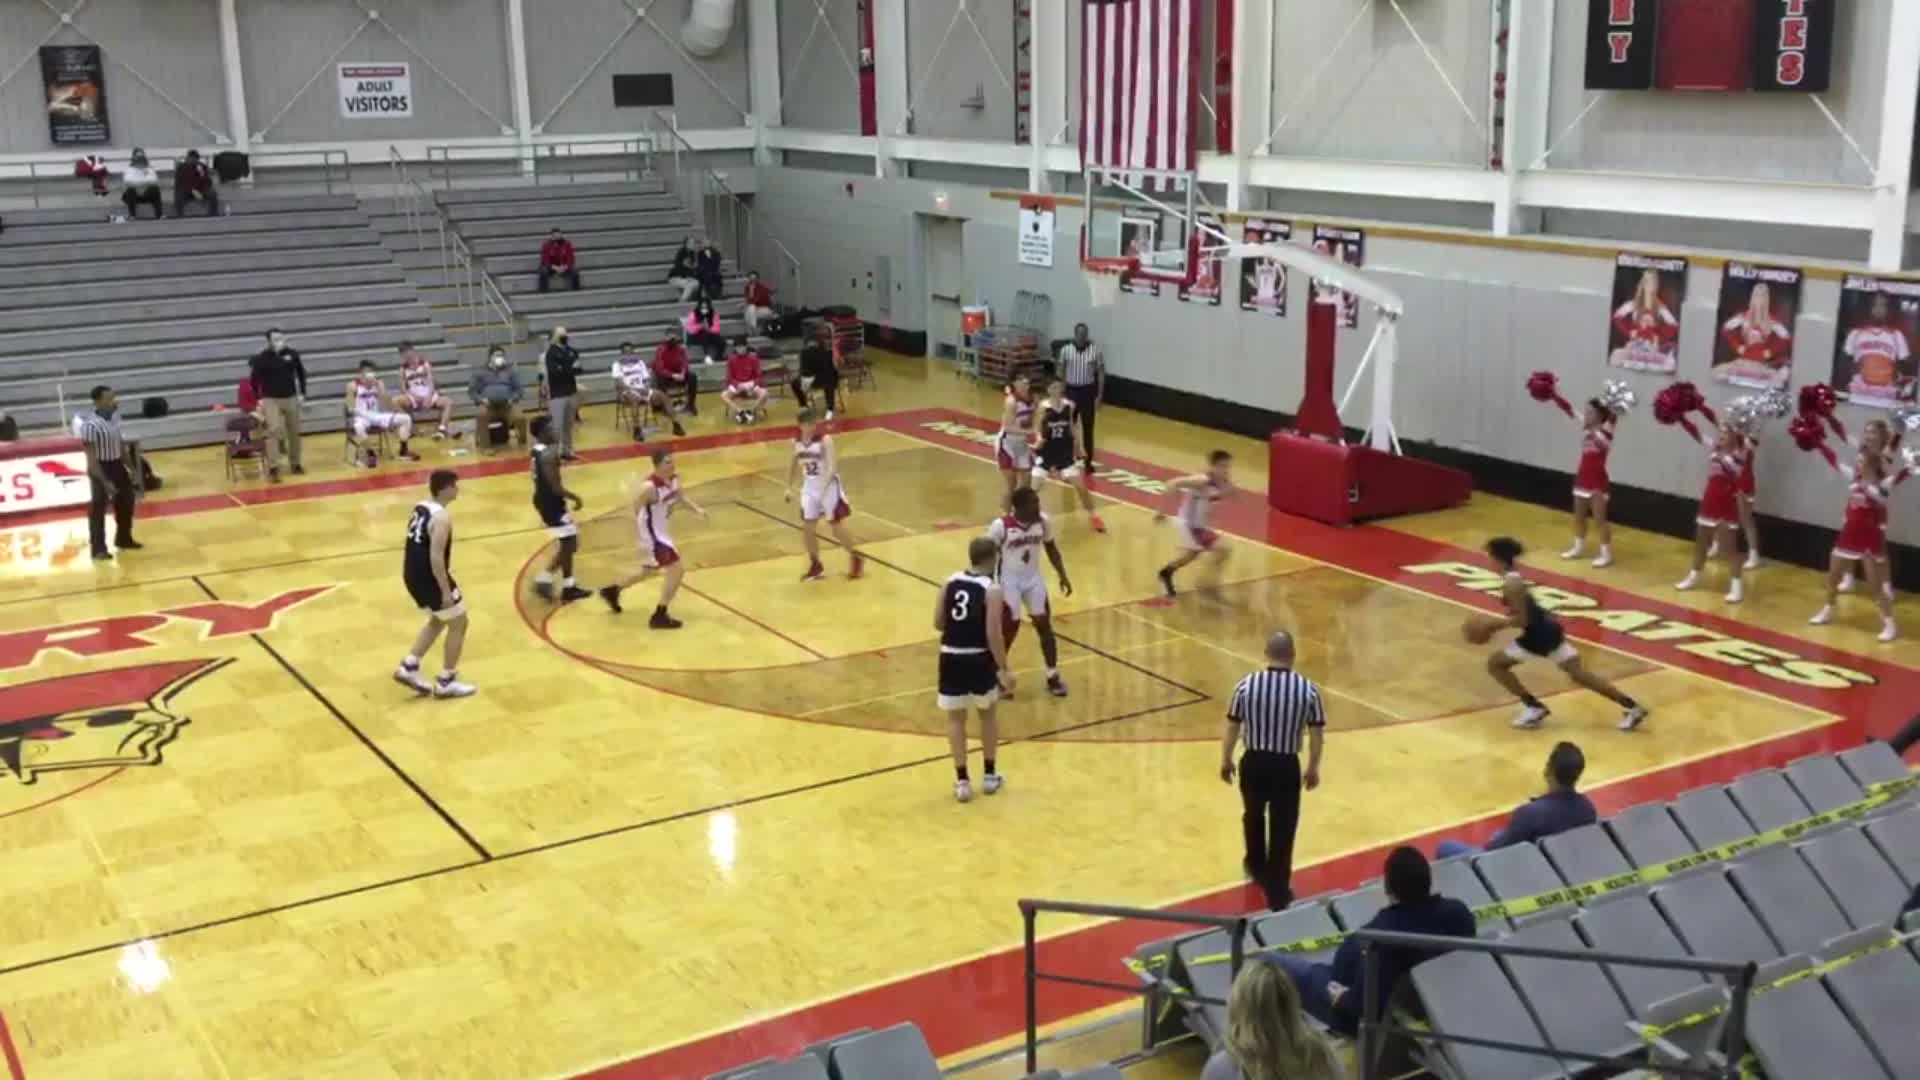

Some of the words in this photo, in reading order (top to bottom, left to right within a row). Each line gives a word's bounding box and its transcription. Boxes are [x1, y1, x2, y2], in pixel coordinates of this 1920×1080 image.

[357, 81, 393, 93] ADULT
[344, 95, 408, 112] VISITORS
[951, 588, 971, 621] 3
